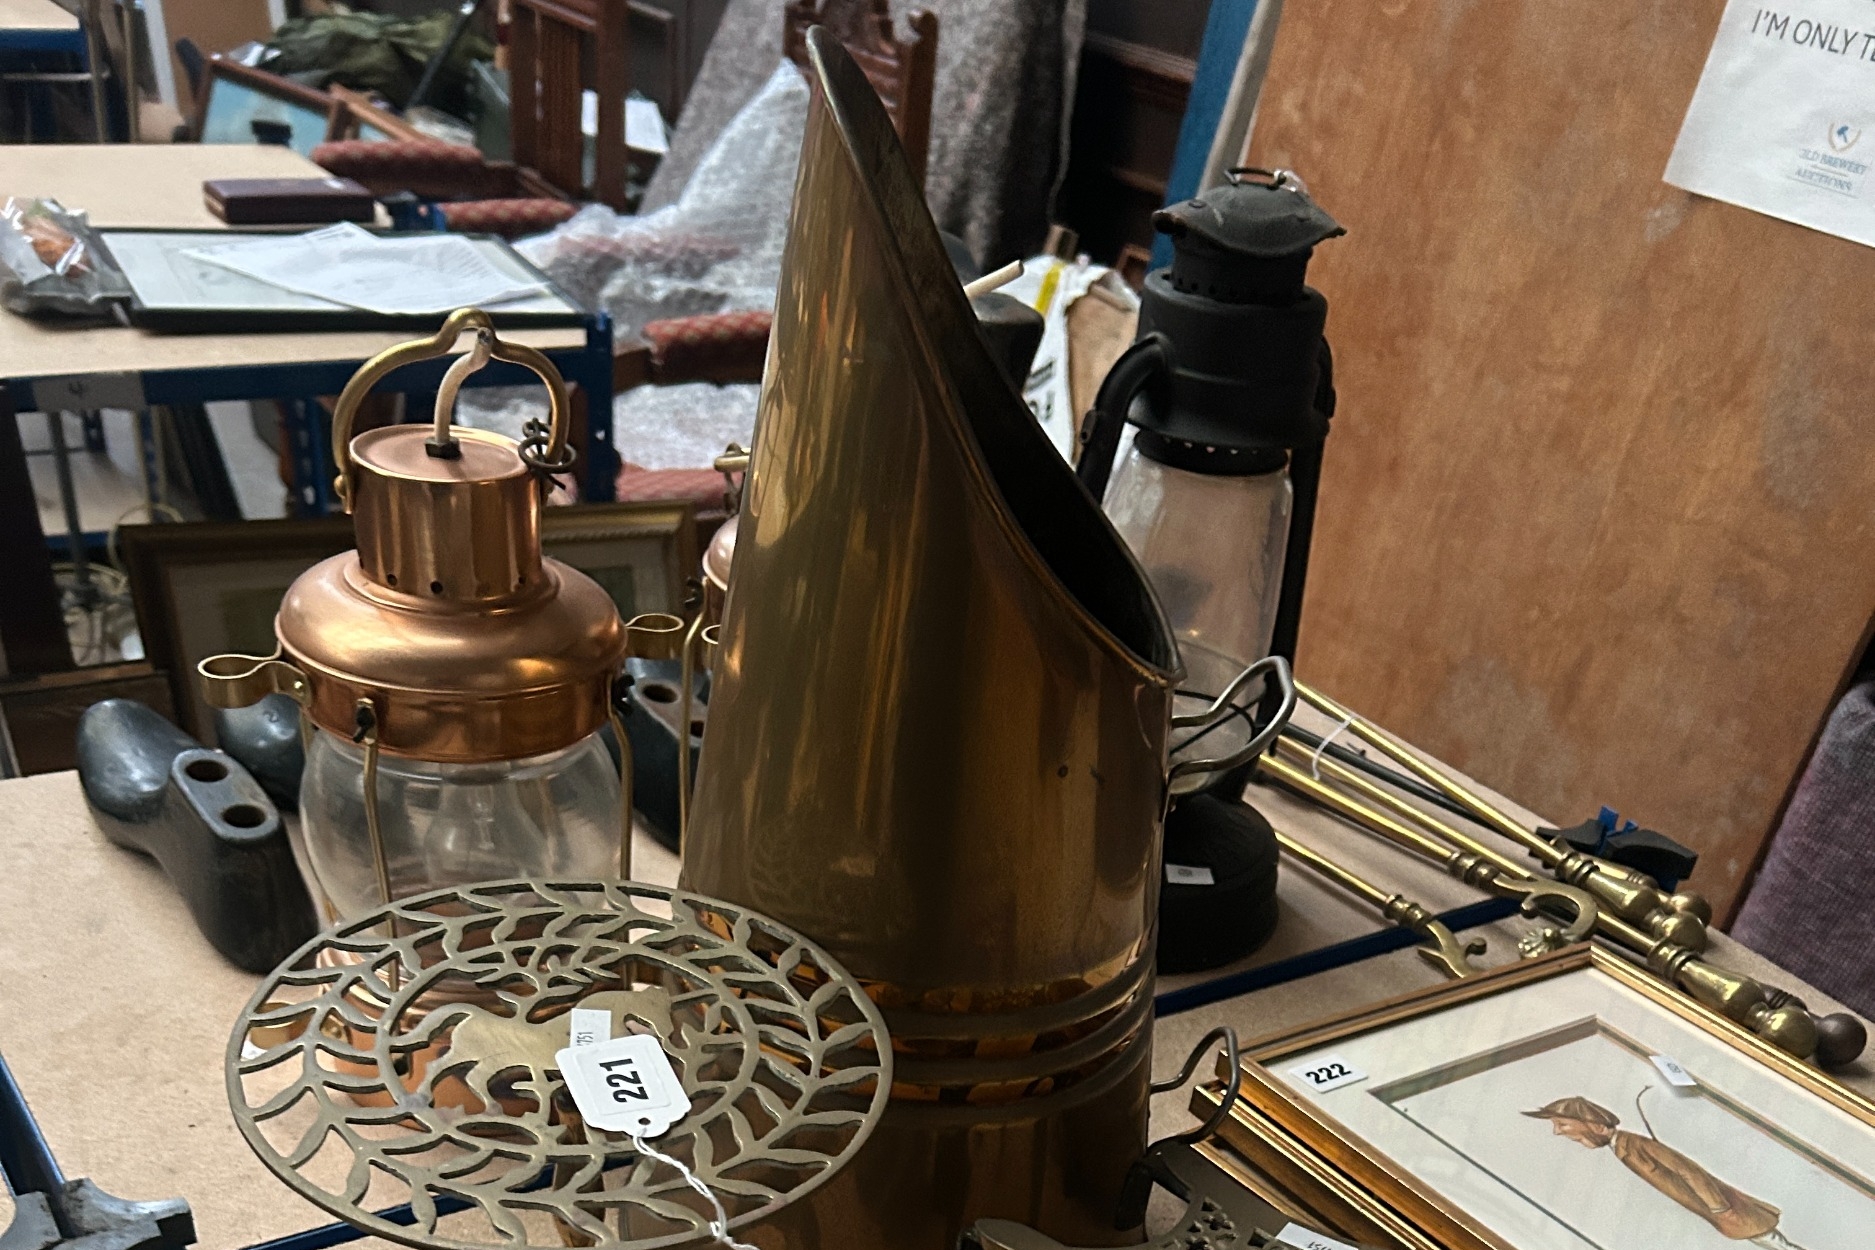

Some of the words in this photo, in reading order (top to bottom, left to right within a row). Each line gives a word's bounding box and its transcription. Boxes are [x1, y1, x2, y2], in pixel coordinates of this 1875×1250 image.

[1751, 9, 1790, 40] I'M
[1793, 19, 1859, 55] ONLY
[576, 1031, 594, 1046] 751
[599, 1058, 649, 1103] 221
[1305, 1063, 1352, 1084] 222
